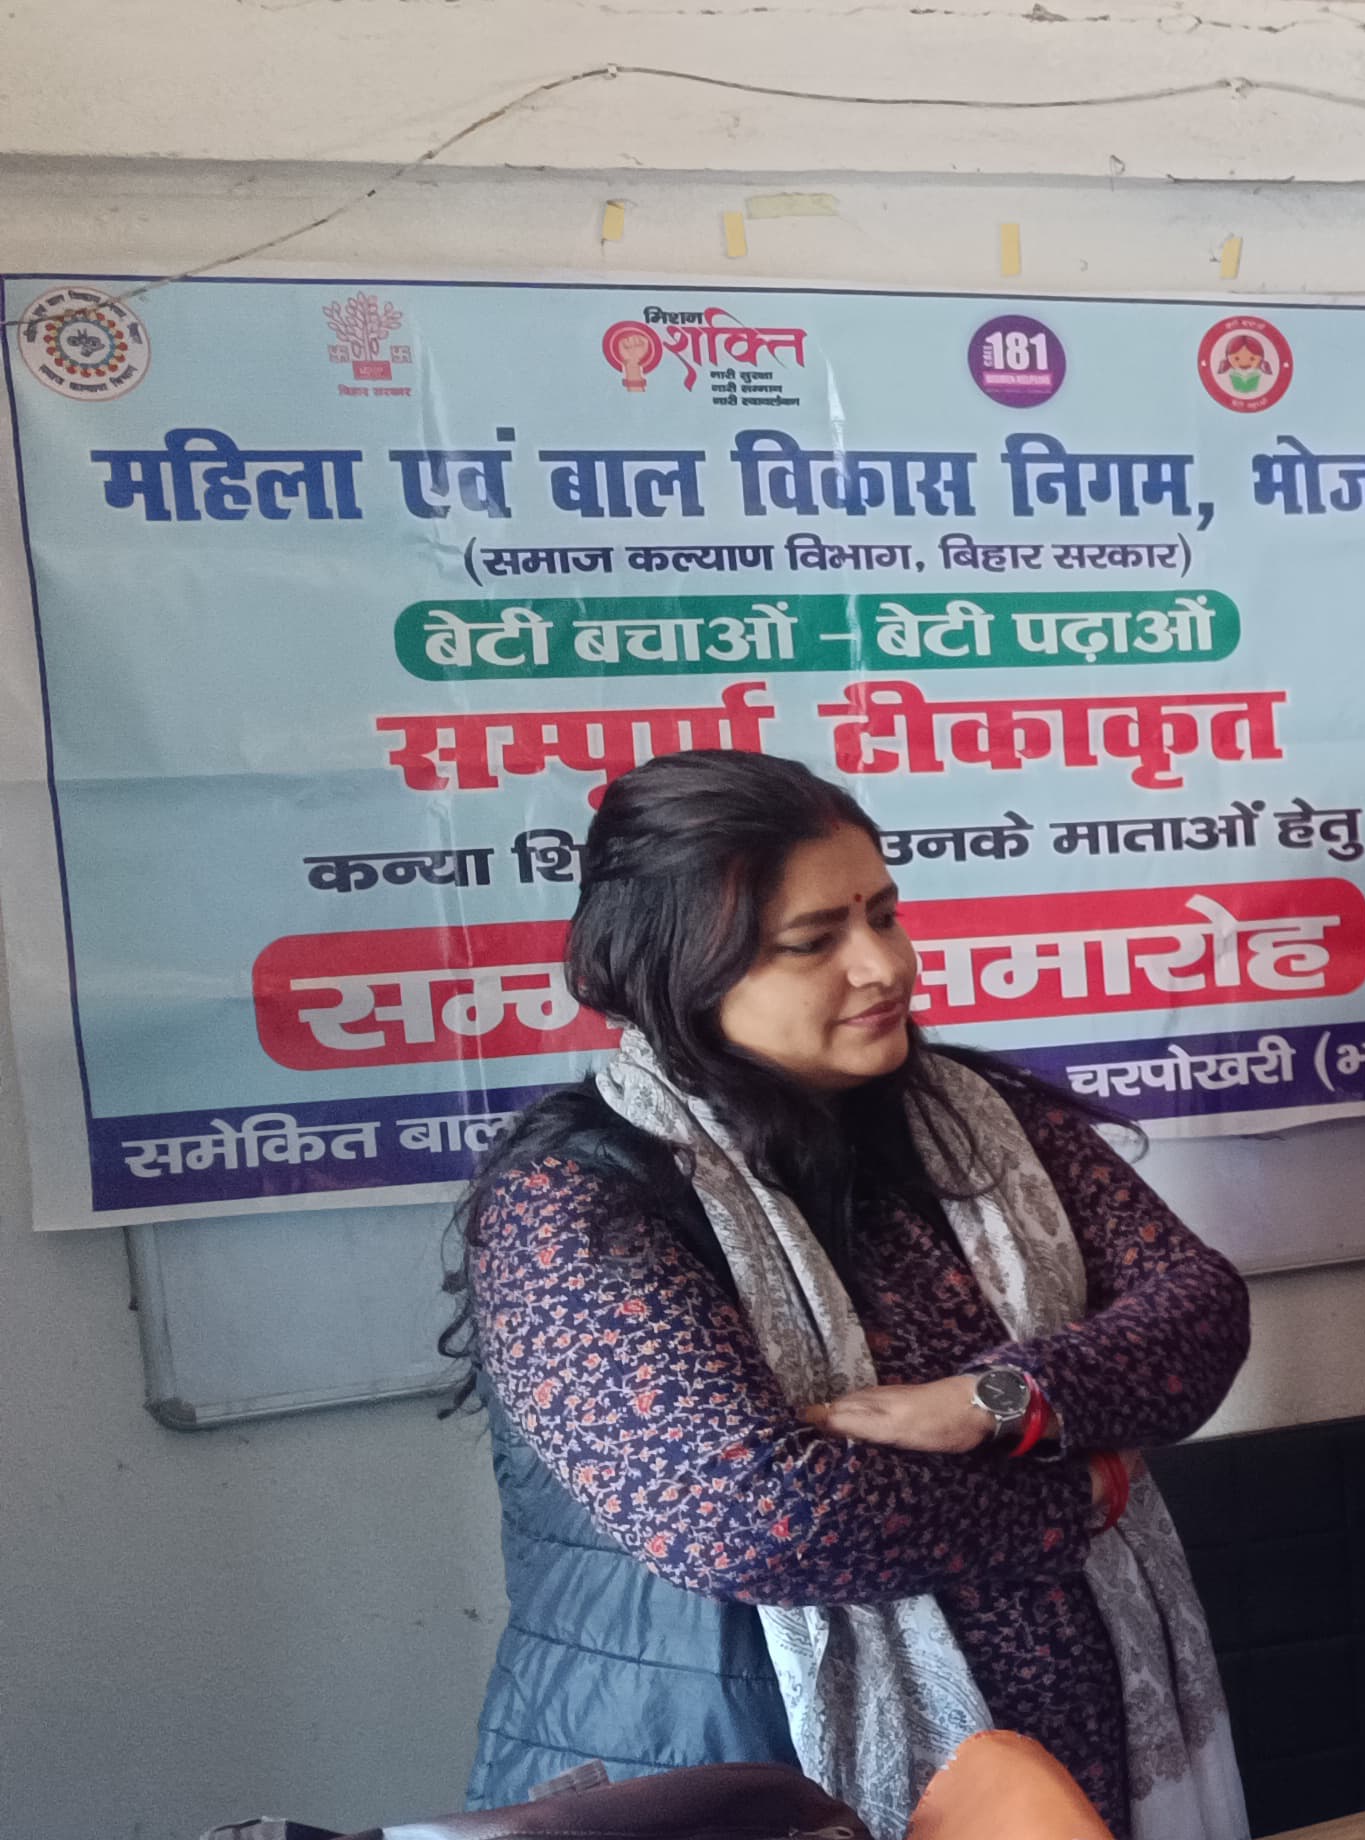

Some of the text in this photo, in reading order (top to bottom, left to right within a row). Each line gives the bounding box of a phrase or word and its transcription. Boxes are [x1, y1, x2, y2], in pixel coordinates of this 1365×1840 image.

[643, 305, 704, 325] मिशन
[662, 306, 809, 393] शक्ति
[984, 331, 1049, 370] 181
[91, 428, 363, 522] महिला
[389, 427, 516, 519] एवं
[539, 449, 706, 518] बाल
[730, 429, 977, 517] विकास
[1000, 433, 1215, 532] निगम,
[464, 532, 1192, 588] (समाज कल्याण विभाग, बिहार सरकार)
[423, 606, 554, 667] बेटी
[572, 601, 799, 665] बचाओं
[875, 600, 996, 659] बेटी
[1010, 595, 1217, 664] पढ़ाओं
[816, 679, 1287, 790] टीकाकृत
[303, 847, 495, 894] कन्या
[880, 811, 1034, 867] उनके
[1049, 800, 1266, 856] माताओं
[1273, 797, 1365, 862] हेतु
[121, 1112, 382, 1179] समेकित
[1066, 1032, 1297, 1100] चरपोखरी
